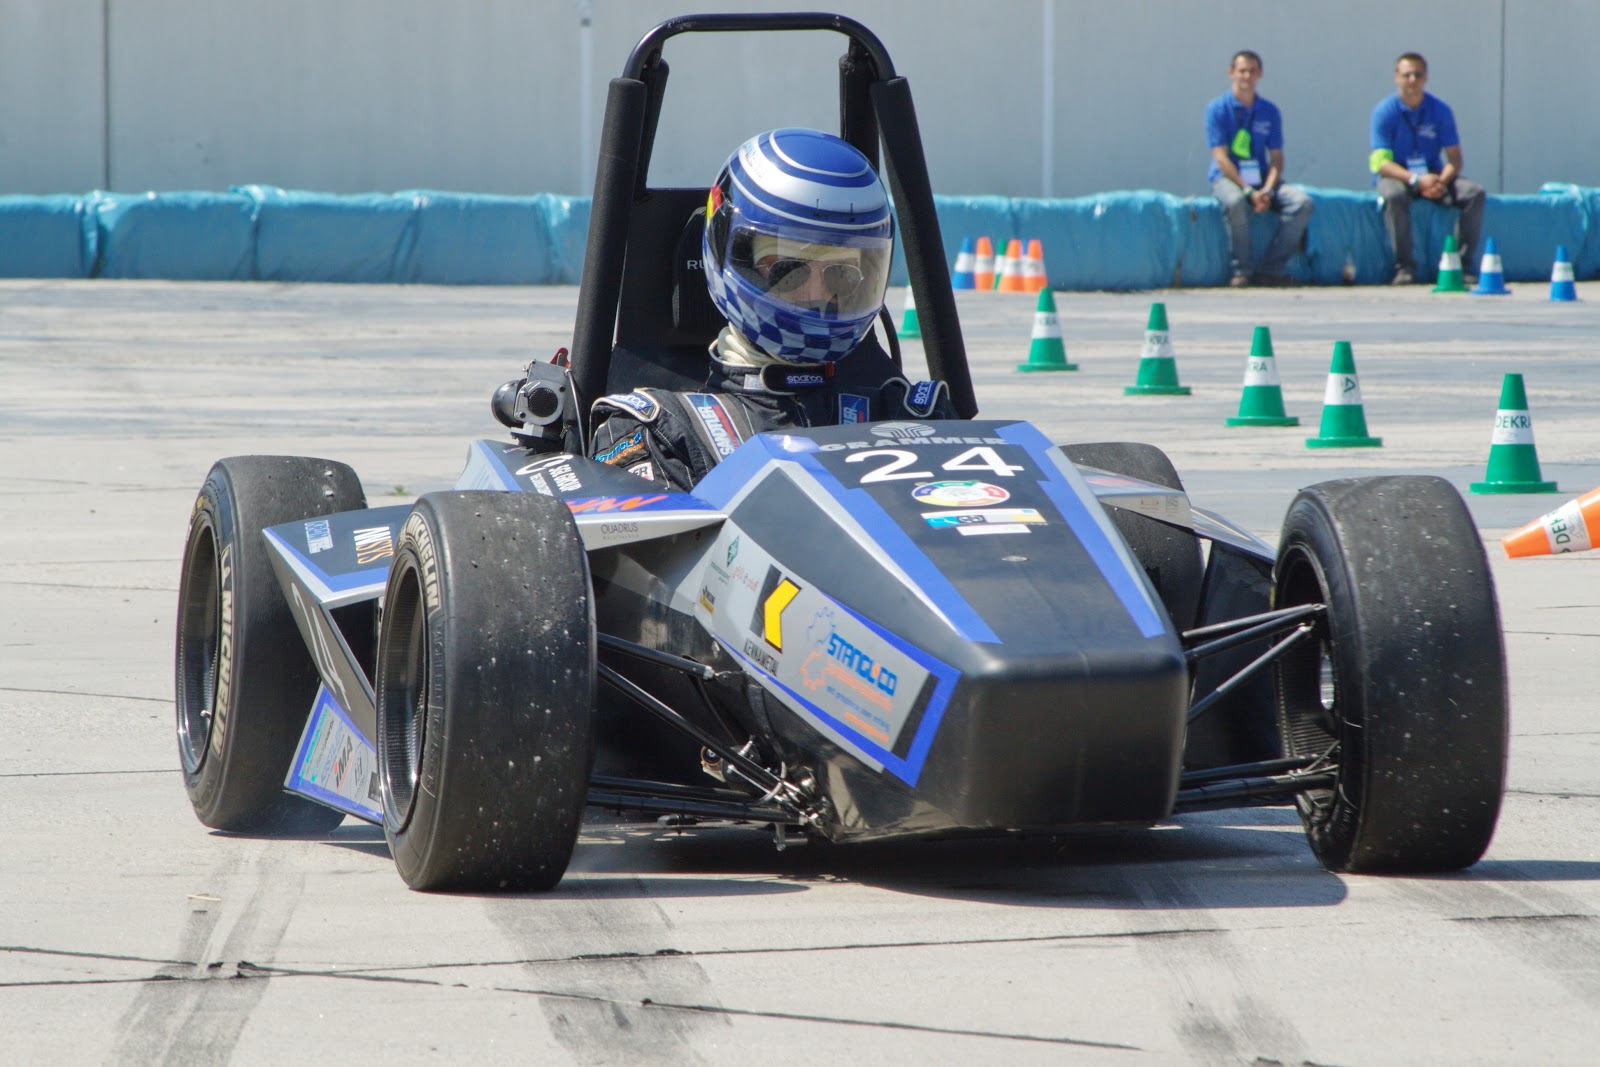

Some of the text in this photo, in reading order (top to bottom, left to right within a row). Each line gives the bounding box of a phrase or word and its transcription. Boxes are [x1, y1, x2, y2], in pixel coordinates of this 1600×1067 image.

[787, 374, 823, 386] sparco
[700, 406, 735, 455] SANDTLER
[819, 436, 1007, 452] GRAMMER
[844, 446, 1025, 483] 24
[601, 522, 638, 534] QUADRUS
[404, 513, 440, 609] MICHELIN
[211, 590, 232, 760] MICHELIN
